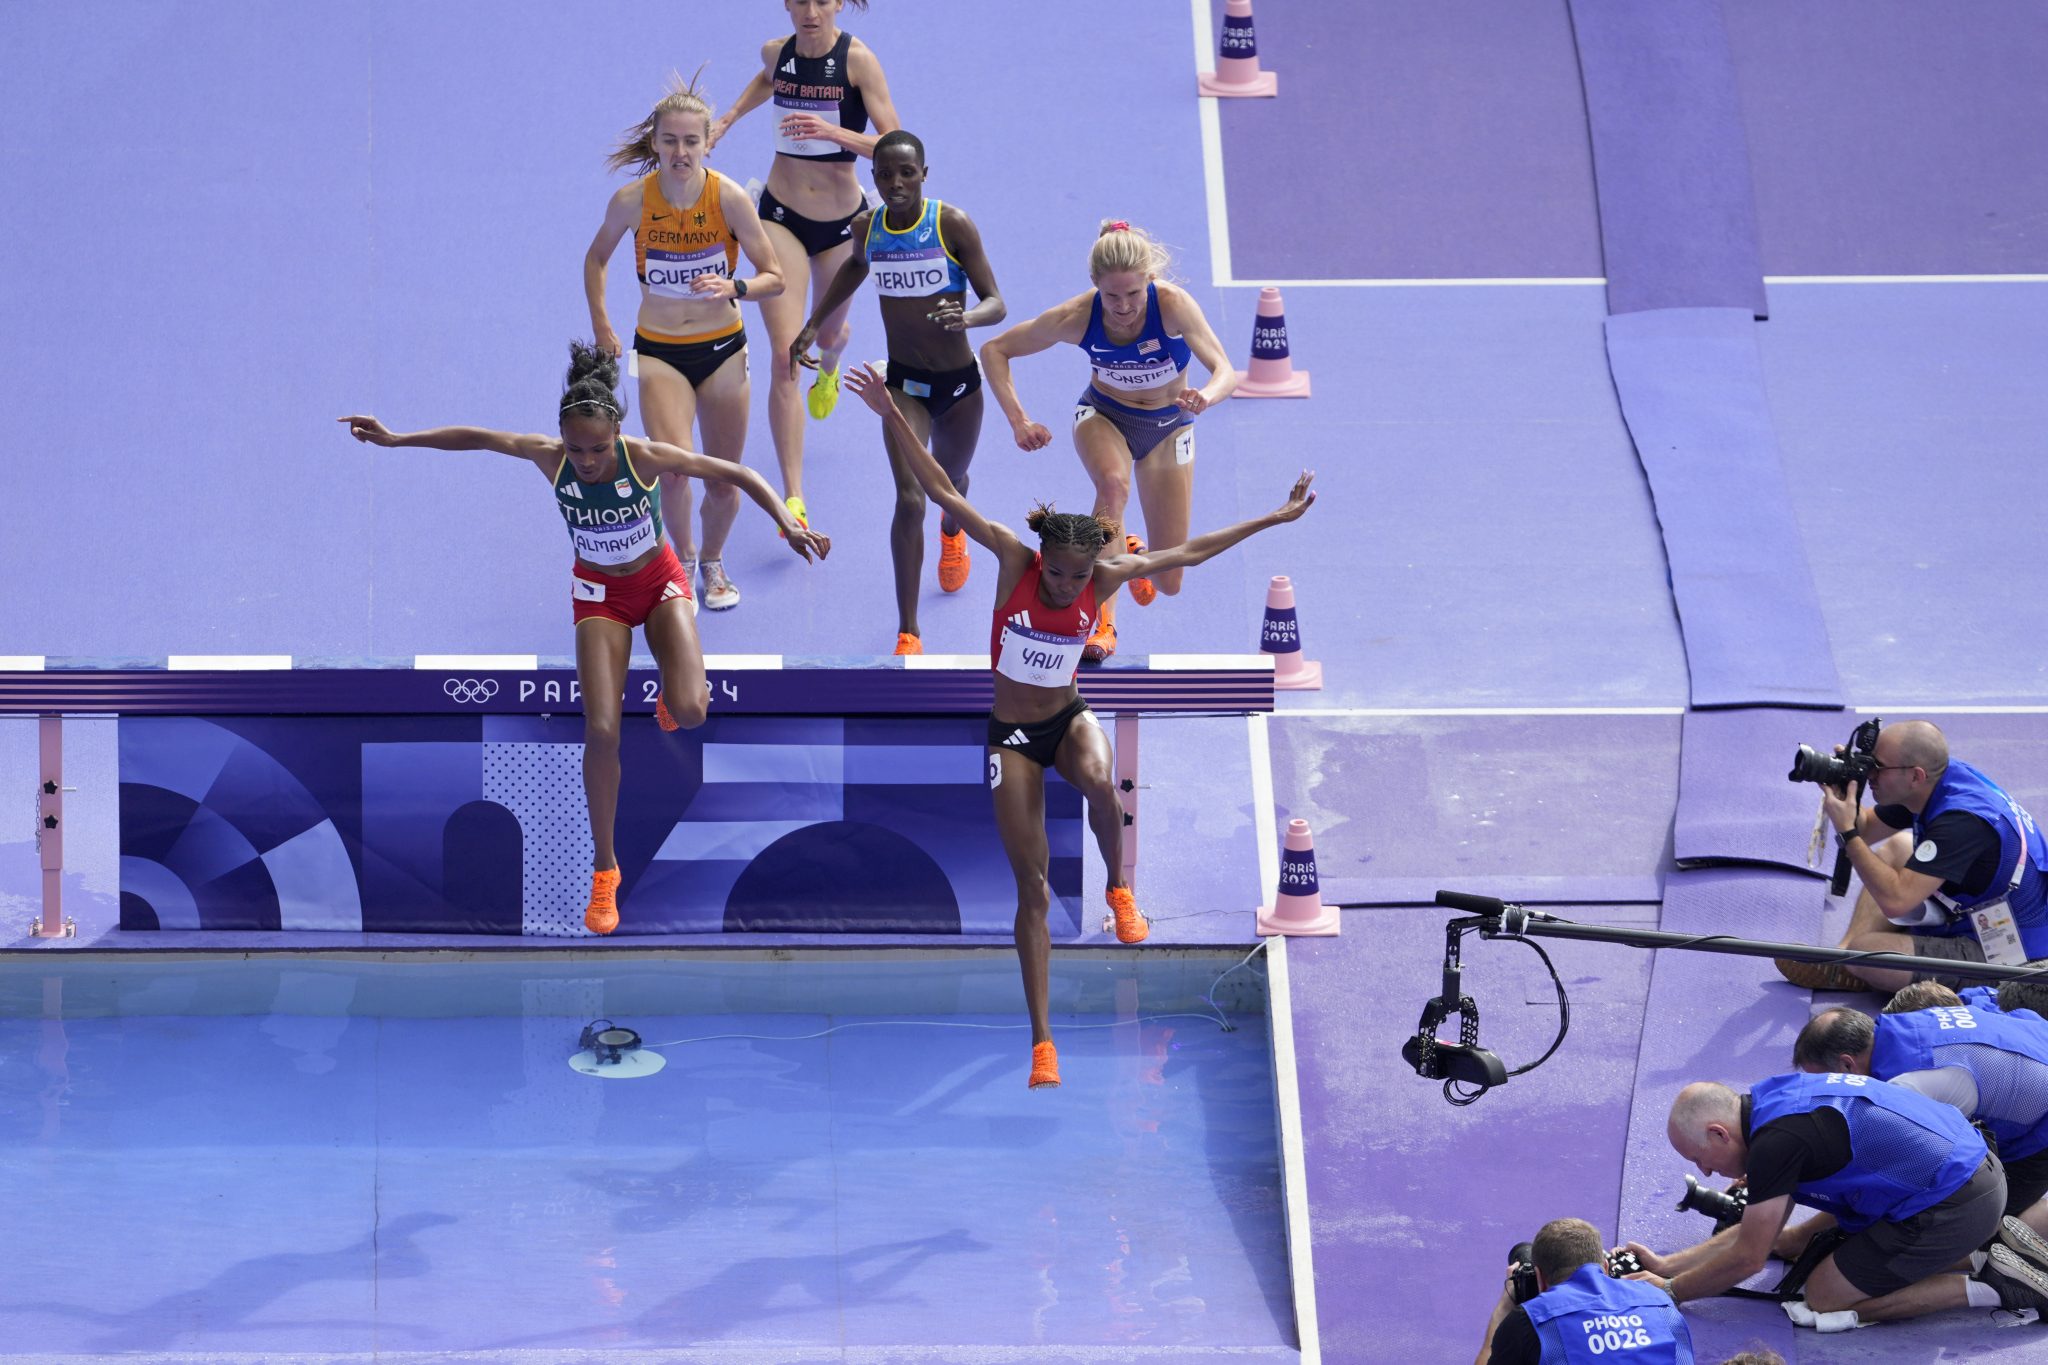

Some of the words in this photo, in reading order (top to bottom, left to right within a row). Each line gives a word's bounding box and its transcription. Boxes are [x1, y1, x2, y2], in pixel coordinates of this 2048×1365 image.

[1223, 27, 1254, 38] PARIS
[1222, 37, 1254, 49] 2024
[800, 86, 844, 99] BRITAIN
[648, 230, 719, 244] GERMANY
[1255, 327, 1286, 338] PARIS
[1255, 338, 1287, 349] 2024
[557, 495, 651, 525] THIOPIA
[577, 524, 651, 552] ALMAYEW
[1264, 619, 1296, 631] PARIS
[1029, 631, 1050, 640] PARIS
[1263, 630, 1297, 642] 2024
[1022, 647, 1064, 670] YAVI
[1282, 861, 1315, 873] PARIS
[1282, 872, 1315, 885] 2024
[1582, 1314, 1643, 1334] PHOTO
[1588, 1328, 1652, 1355] 0026
